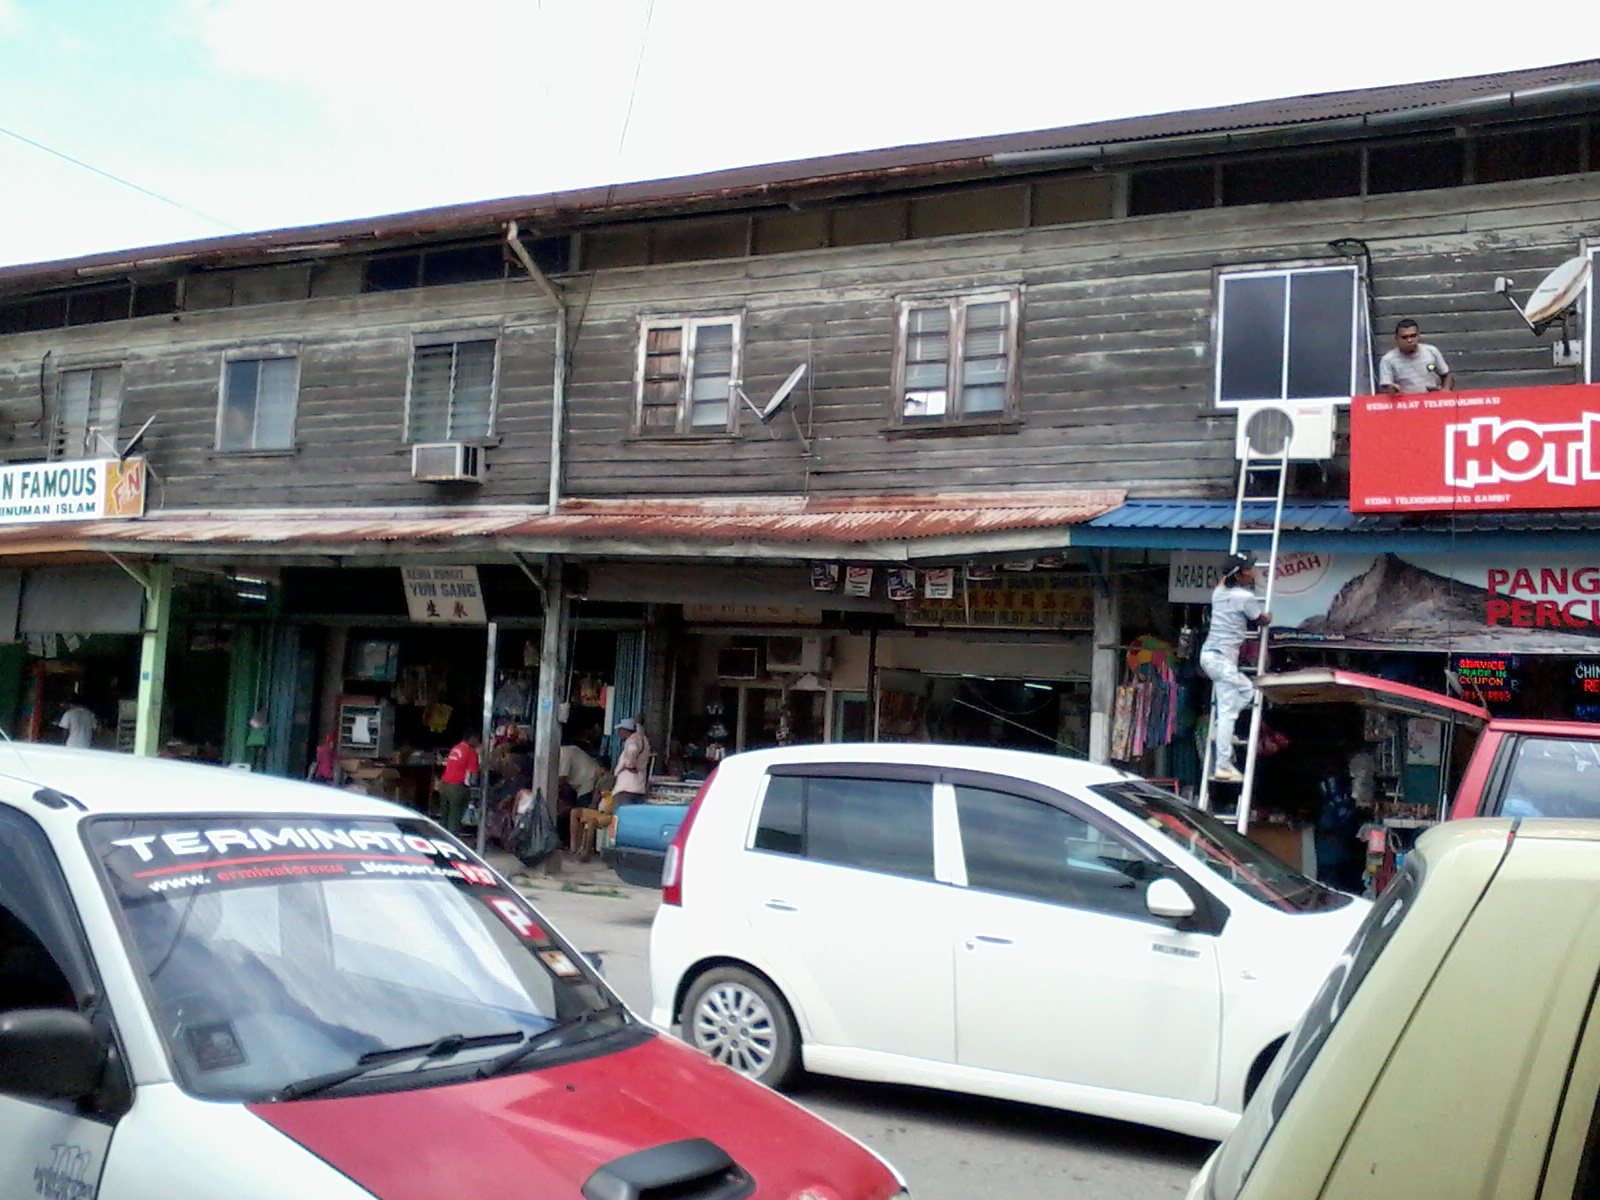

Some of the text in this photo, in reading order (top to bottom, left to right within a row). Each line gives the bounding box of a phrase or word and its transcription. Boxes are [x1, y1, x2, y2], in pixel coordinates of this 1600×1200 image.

[20, 467, 97, 499] FAMOUS
[0, 502, 96, 517] INUMAN ISLAM
[1487, 567, 1600, 596] PANG
[111, 828, 468, 862] TERMINATOR
